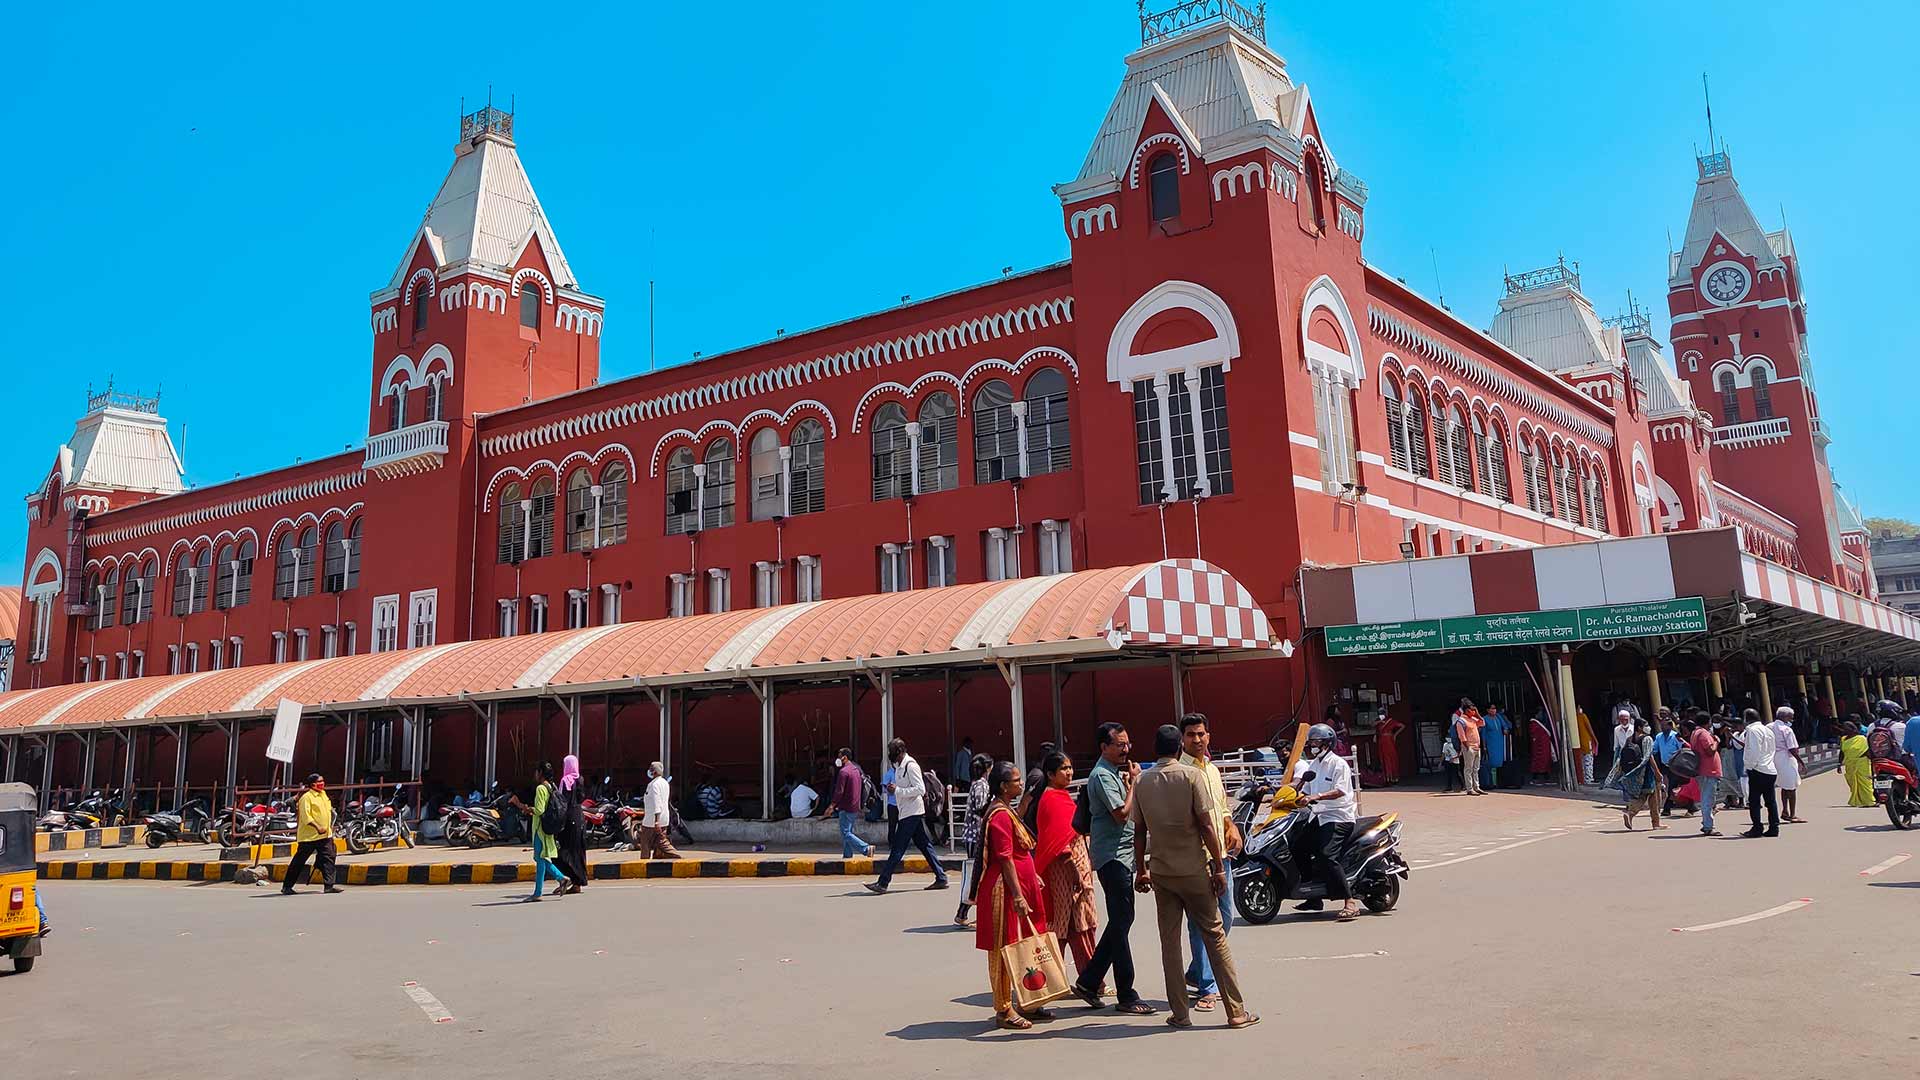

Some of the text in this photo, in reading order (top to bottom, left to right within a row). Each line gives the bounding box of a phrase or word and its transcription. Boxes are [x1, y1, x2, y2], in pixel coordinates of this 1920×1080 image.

[1639, 604, 1668, 612] Thalaivar
[1586, 609, 1699, 626] Dr. M.G.Ramachandran
[1533, 625, 1550, 638] रेलवे
[1552, 625, 1573, 638] स्टेशन
[1586, 620, 1702, 637] Central Railway Station
[1342, 643, 1367, 653] மத்திய
[1390, 640, 1425, 650] நிலையம்
